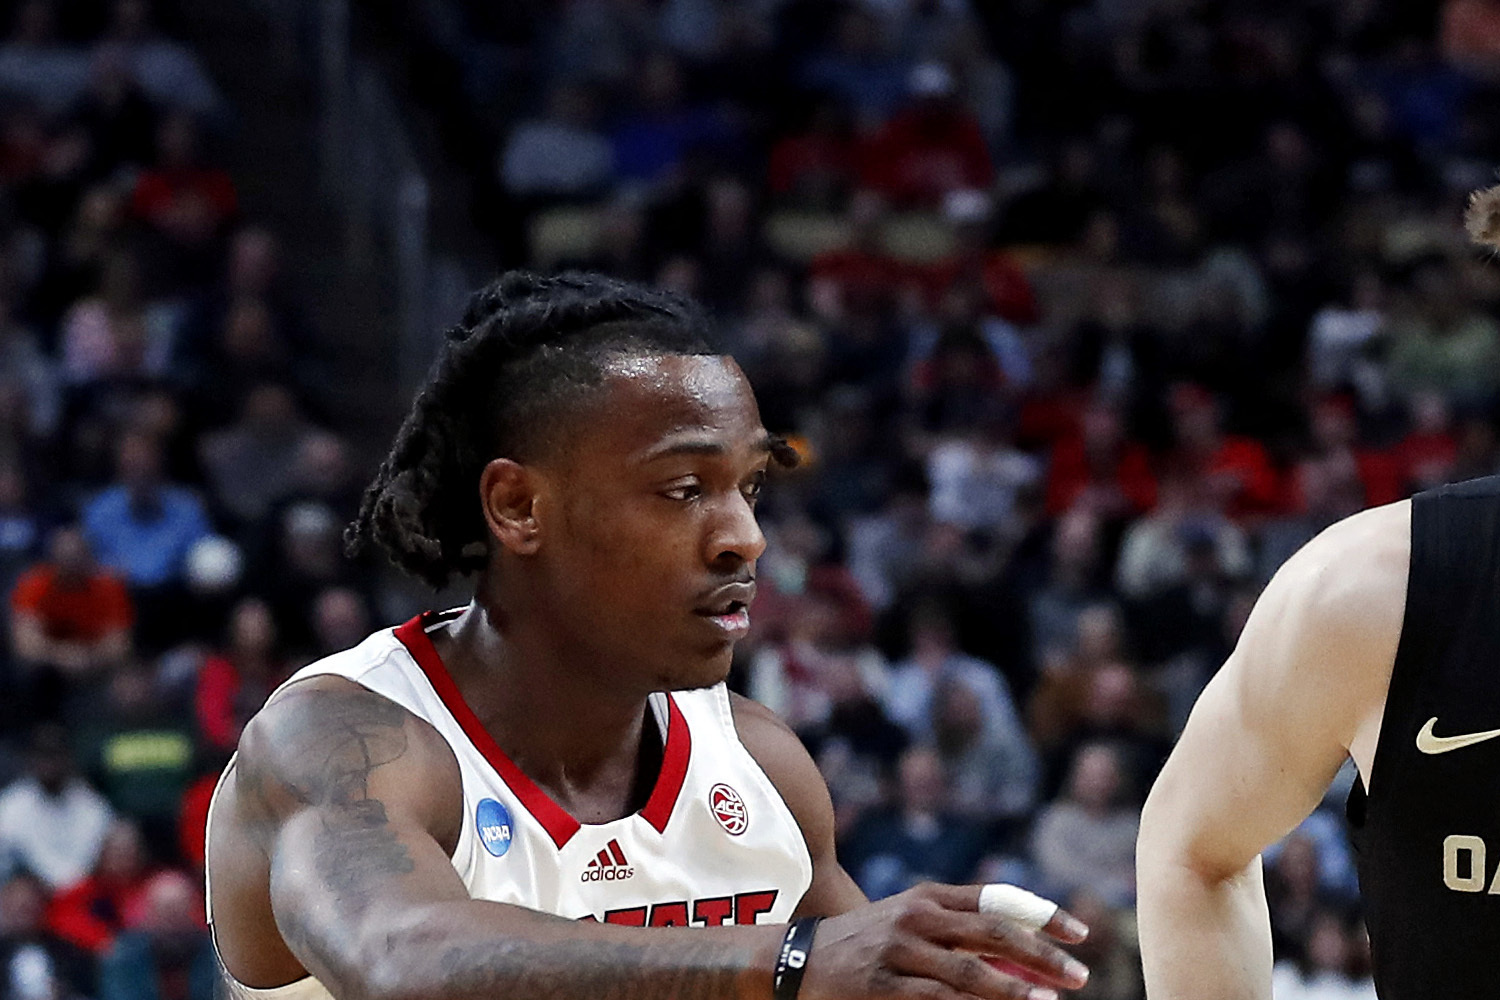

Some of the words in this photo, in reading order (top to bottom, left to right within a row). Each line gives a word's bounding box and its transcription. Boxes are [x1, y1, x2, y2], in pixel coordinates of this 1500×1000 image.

[714, 799, 744, 815] ACC
[482, 825, 511, 842] NCAA
[581, 866, 634, 882] adidas
